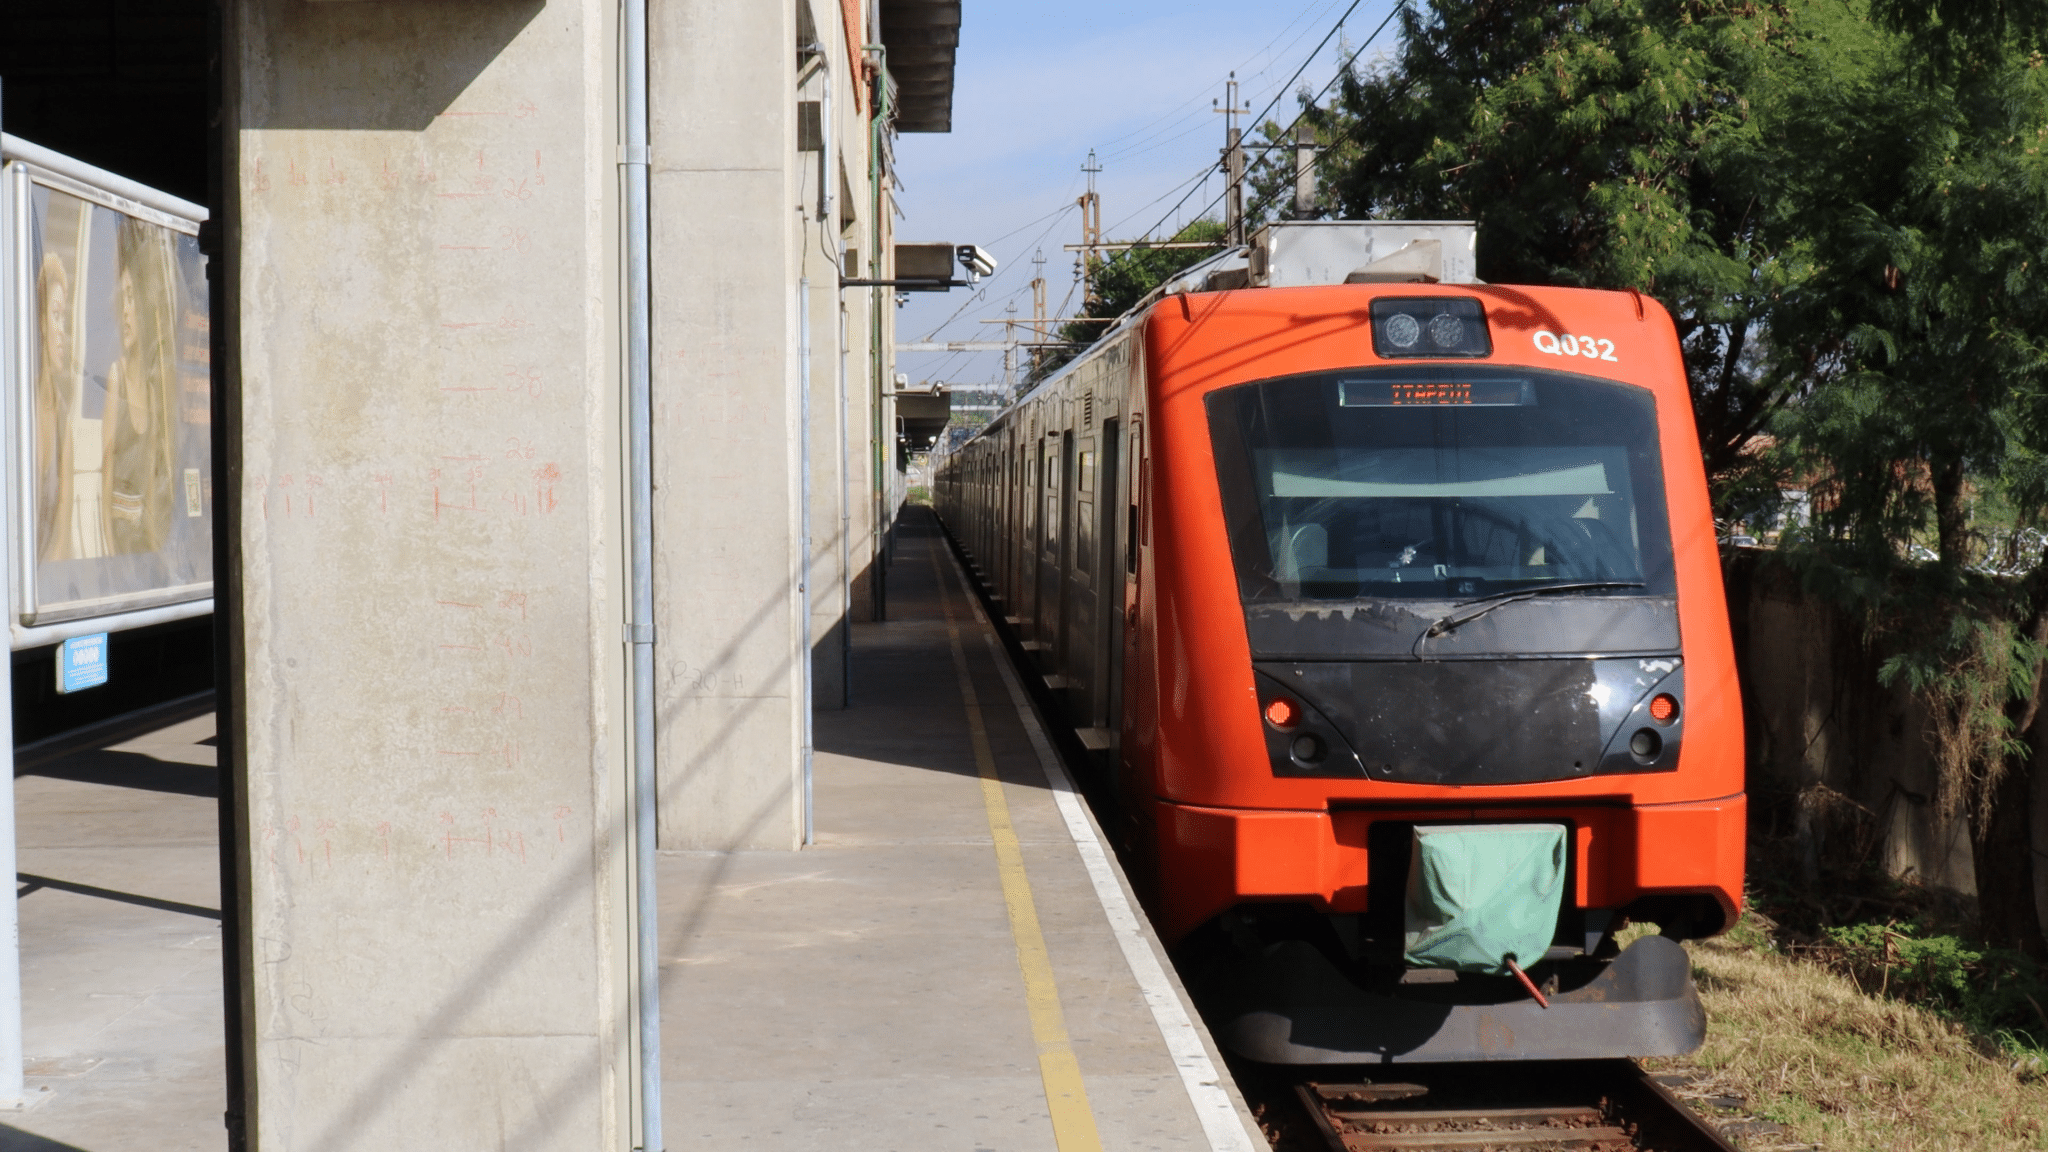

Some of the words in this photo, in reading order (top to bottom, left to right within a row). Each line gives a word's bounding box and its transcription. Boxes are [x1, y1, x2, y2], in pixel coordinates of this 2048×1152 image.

[503, 177, 533, 201] 26
[1533, 331, 1618, 362] Q032
[1391, 383, 1472, 404] ITAPEVI
[671, 660, 744, 692] P-20-H
